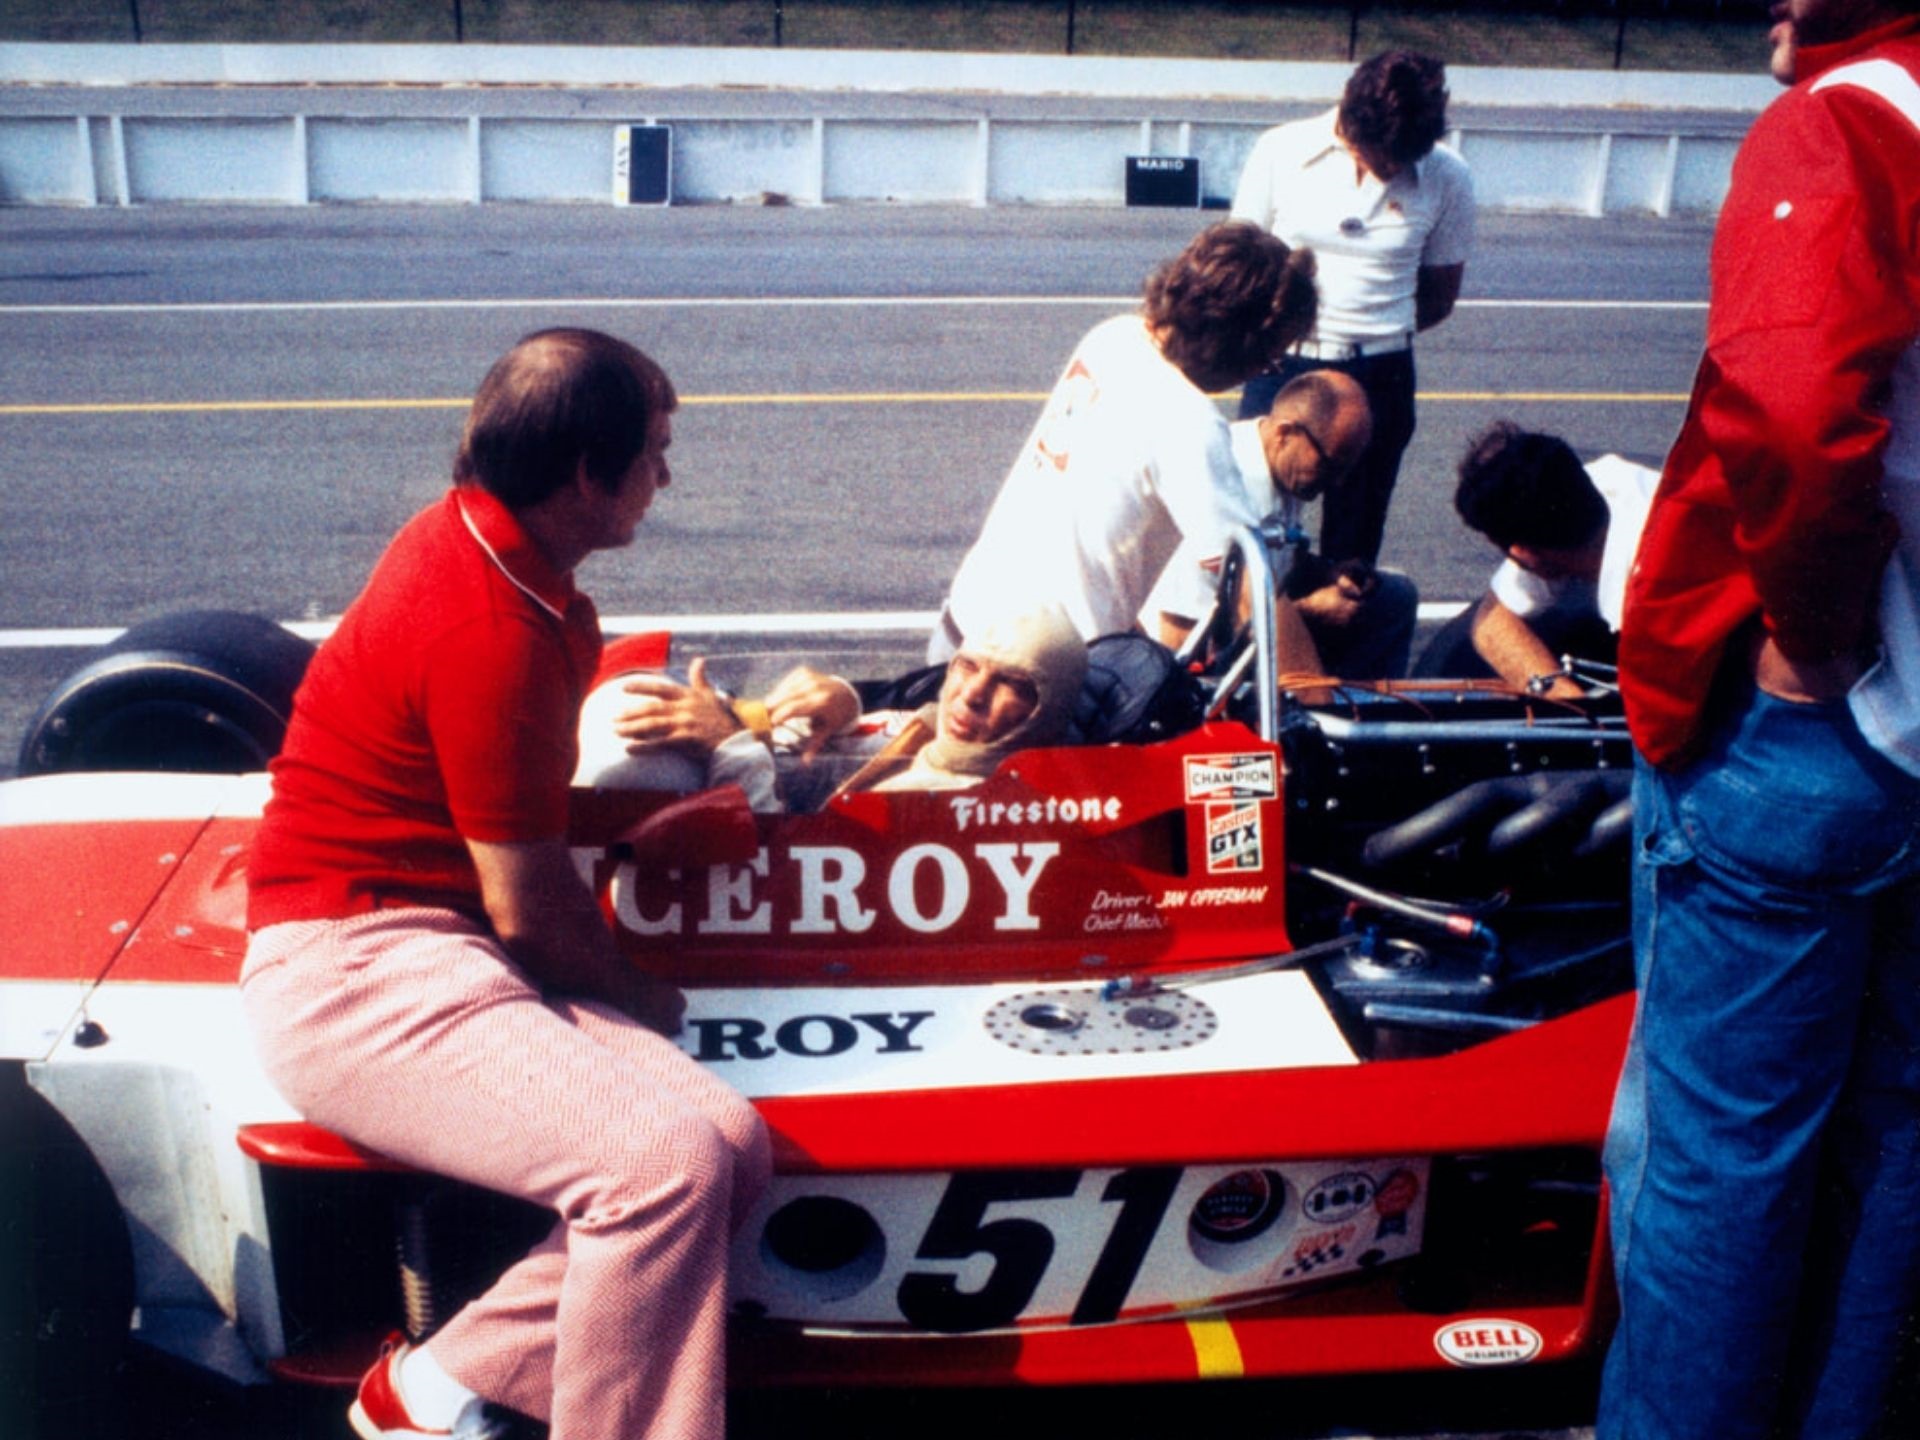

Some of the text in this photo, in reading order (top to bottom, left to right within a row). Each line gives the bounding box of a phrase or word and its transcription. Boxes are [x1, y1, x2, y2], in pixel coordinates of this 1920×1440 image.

[1136, 159, 1184, 171] MARIO
[1192, 769, 1269, 786] CHAMPION
[950, 796, 1122, 831] Firestone
[1211, 821, 1257, 854] GTX
[1154, 890, 1188, 909] JAN
[1083, 912, 1124, 932] Chief
[897, 1167, 1185, 1333] 51
[1453, 1328, 1527, 1347] BELL
